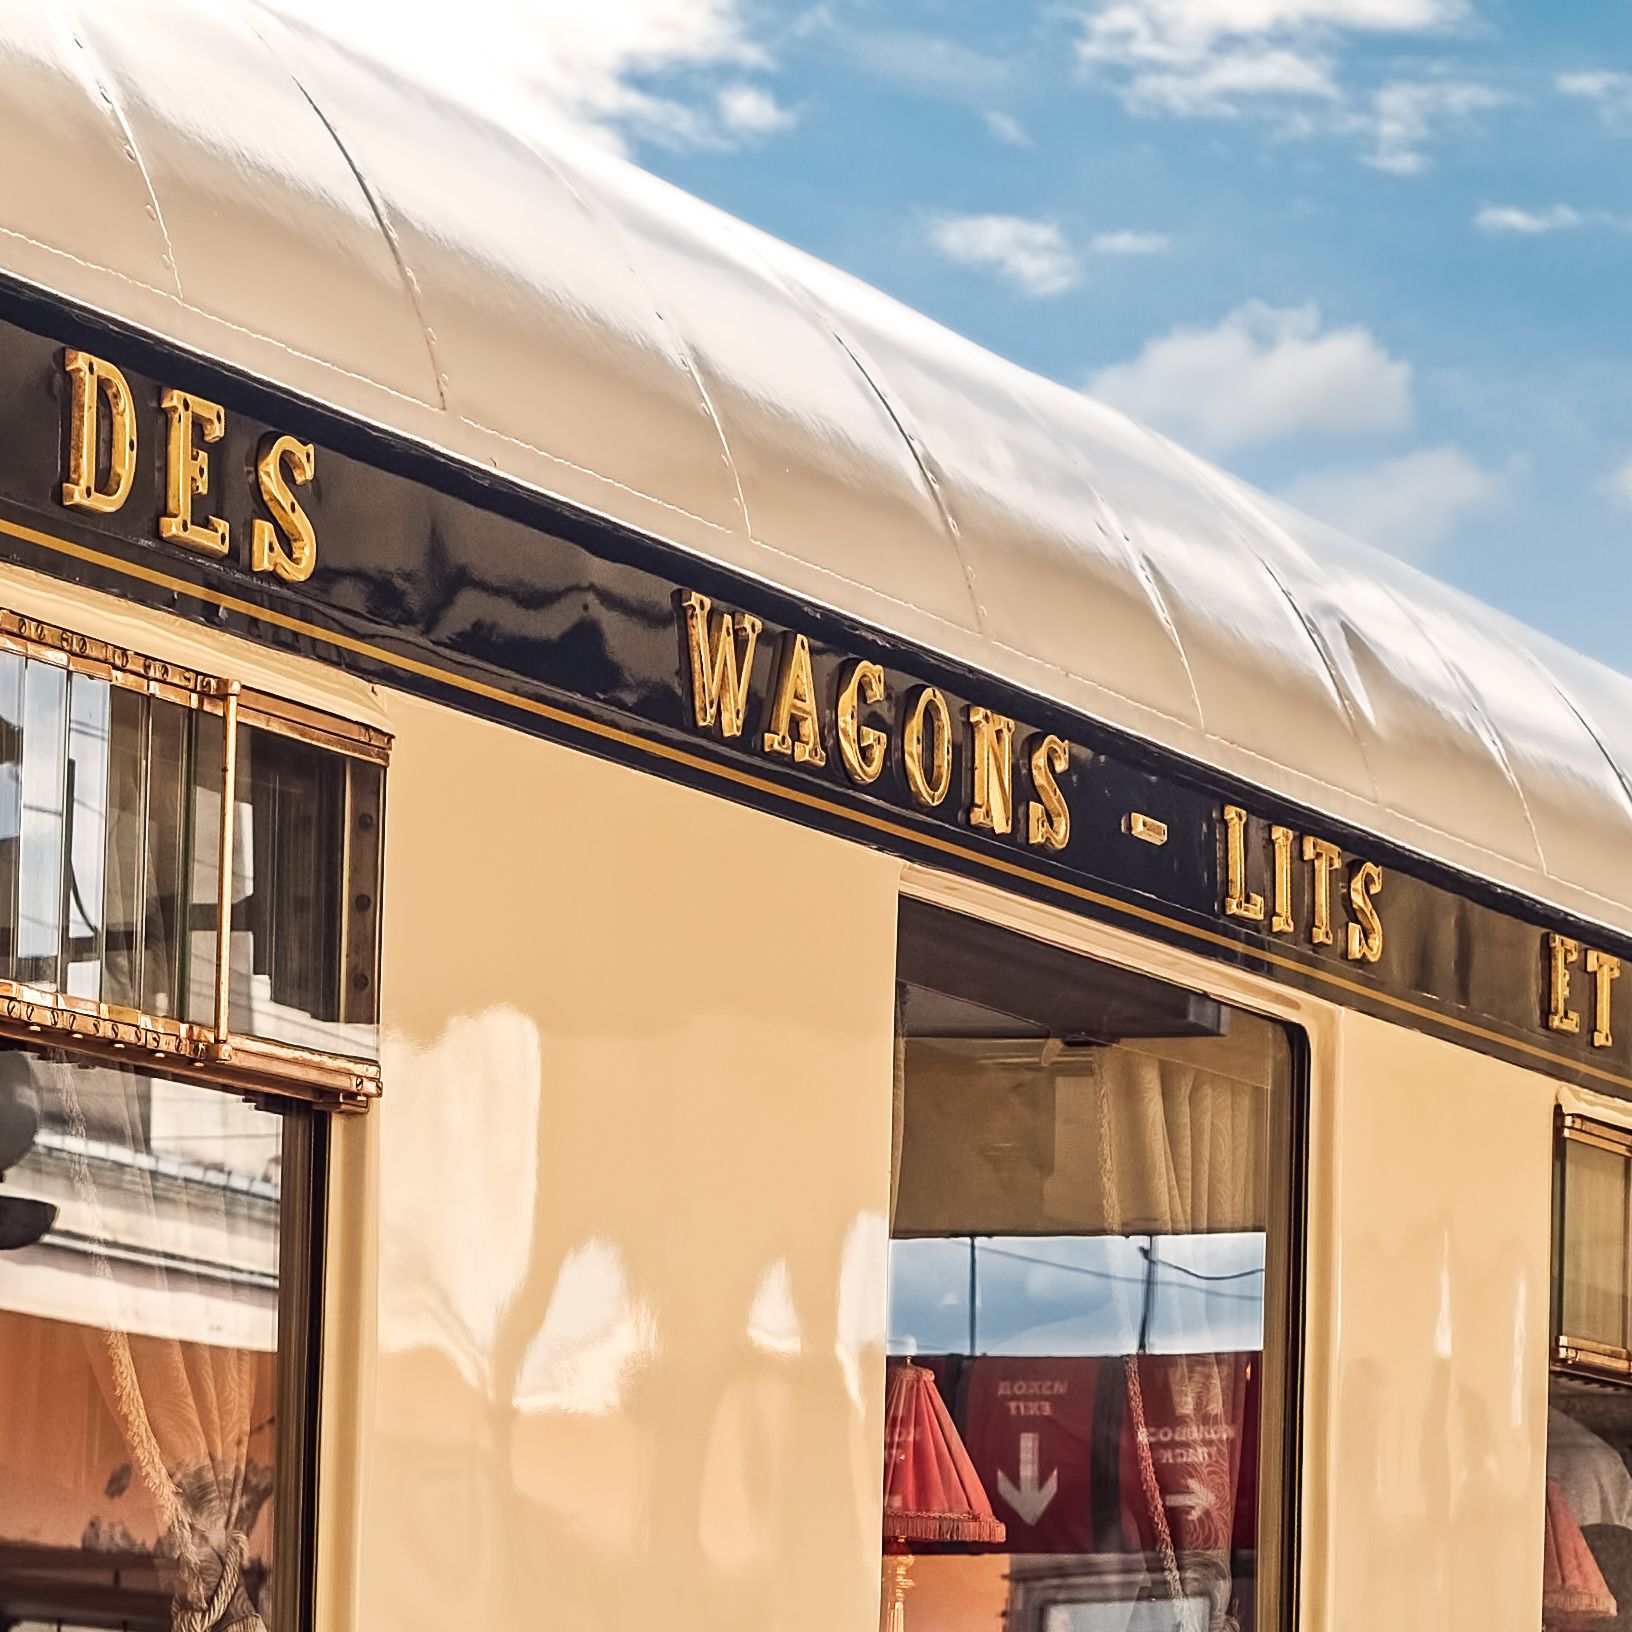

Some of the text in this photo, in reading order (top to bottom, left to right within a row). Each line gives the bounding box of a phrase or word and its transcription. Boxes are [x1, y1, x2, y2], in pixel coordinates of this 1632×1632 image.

[63, 348, 317, 583] DES
[682, 590, 1070, 851] WAGONS
[1223, 805, 1383, 962] LITS
[1548, 933, 1620, 1047] ET
